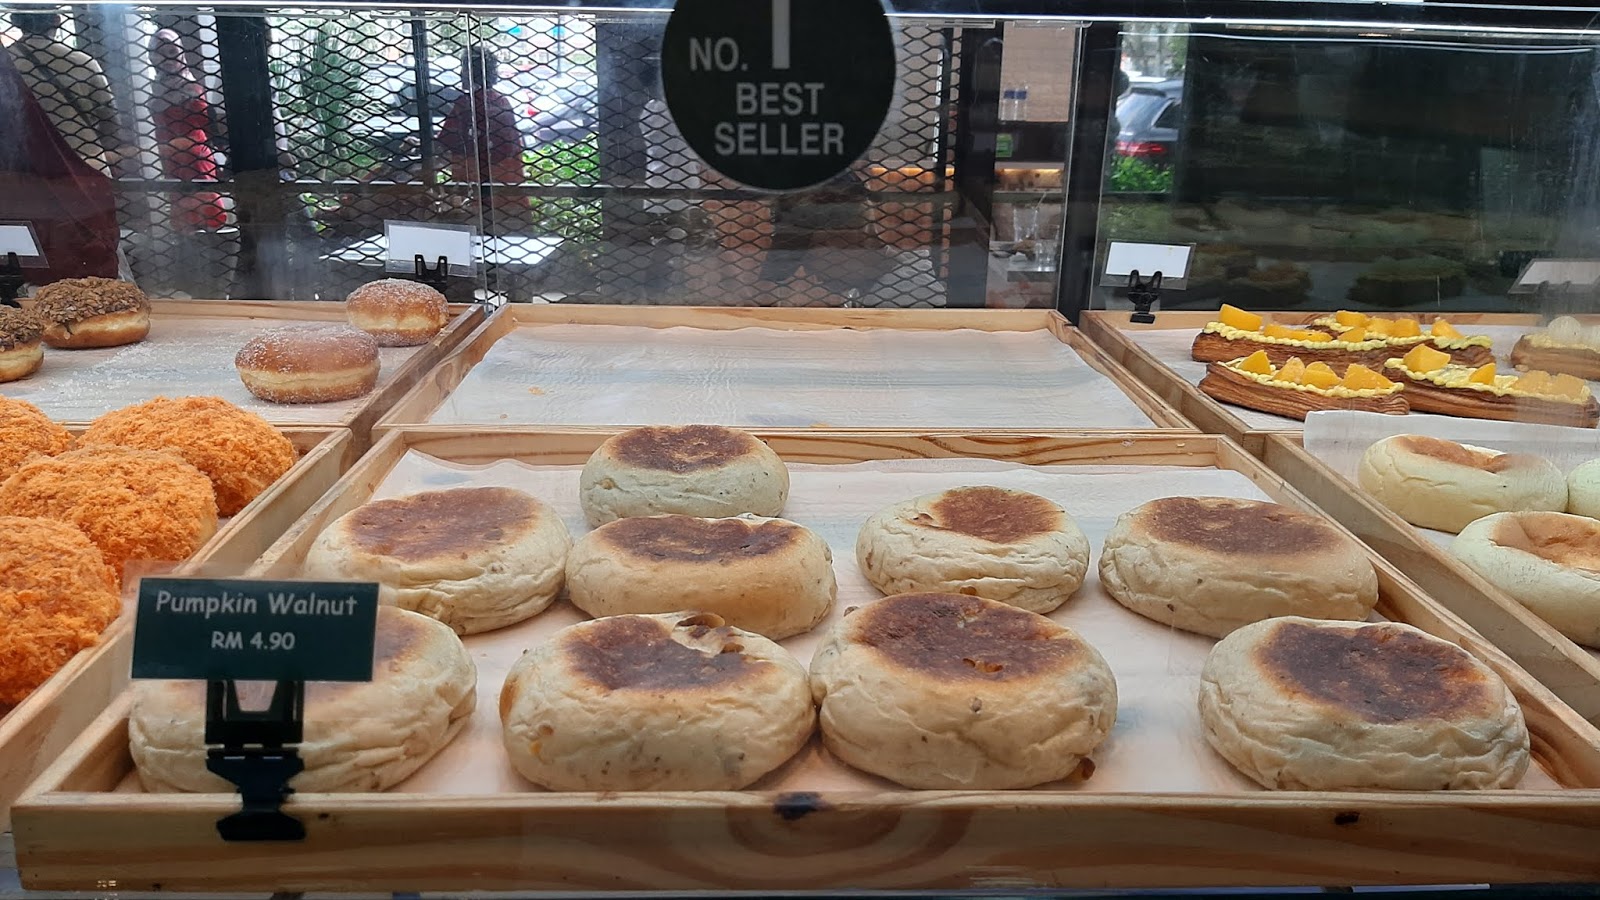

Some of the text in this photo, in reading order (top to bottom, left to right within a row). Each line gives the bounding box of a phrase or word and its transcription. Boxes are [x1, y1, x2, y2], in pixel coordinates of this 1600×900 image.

[689, 37, 749, 72] NO.
[735, 82, 825, 116] BEST
[714, 122, 845, 156] SELLER
[155, 590, 358, 620] Pumpkin Walnut
[211, 631, 296, 651] RM 4.90
